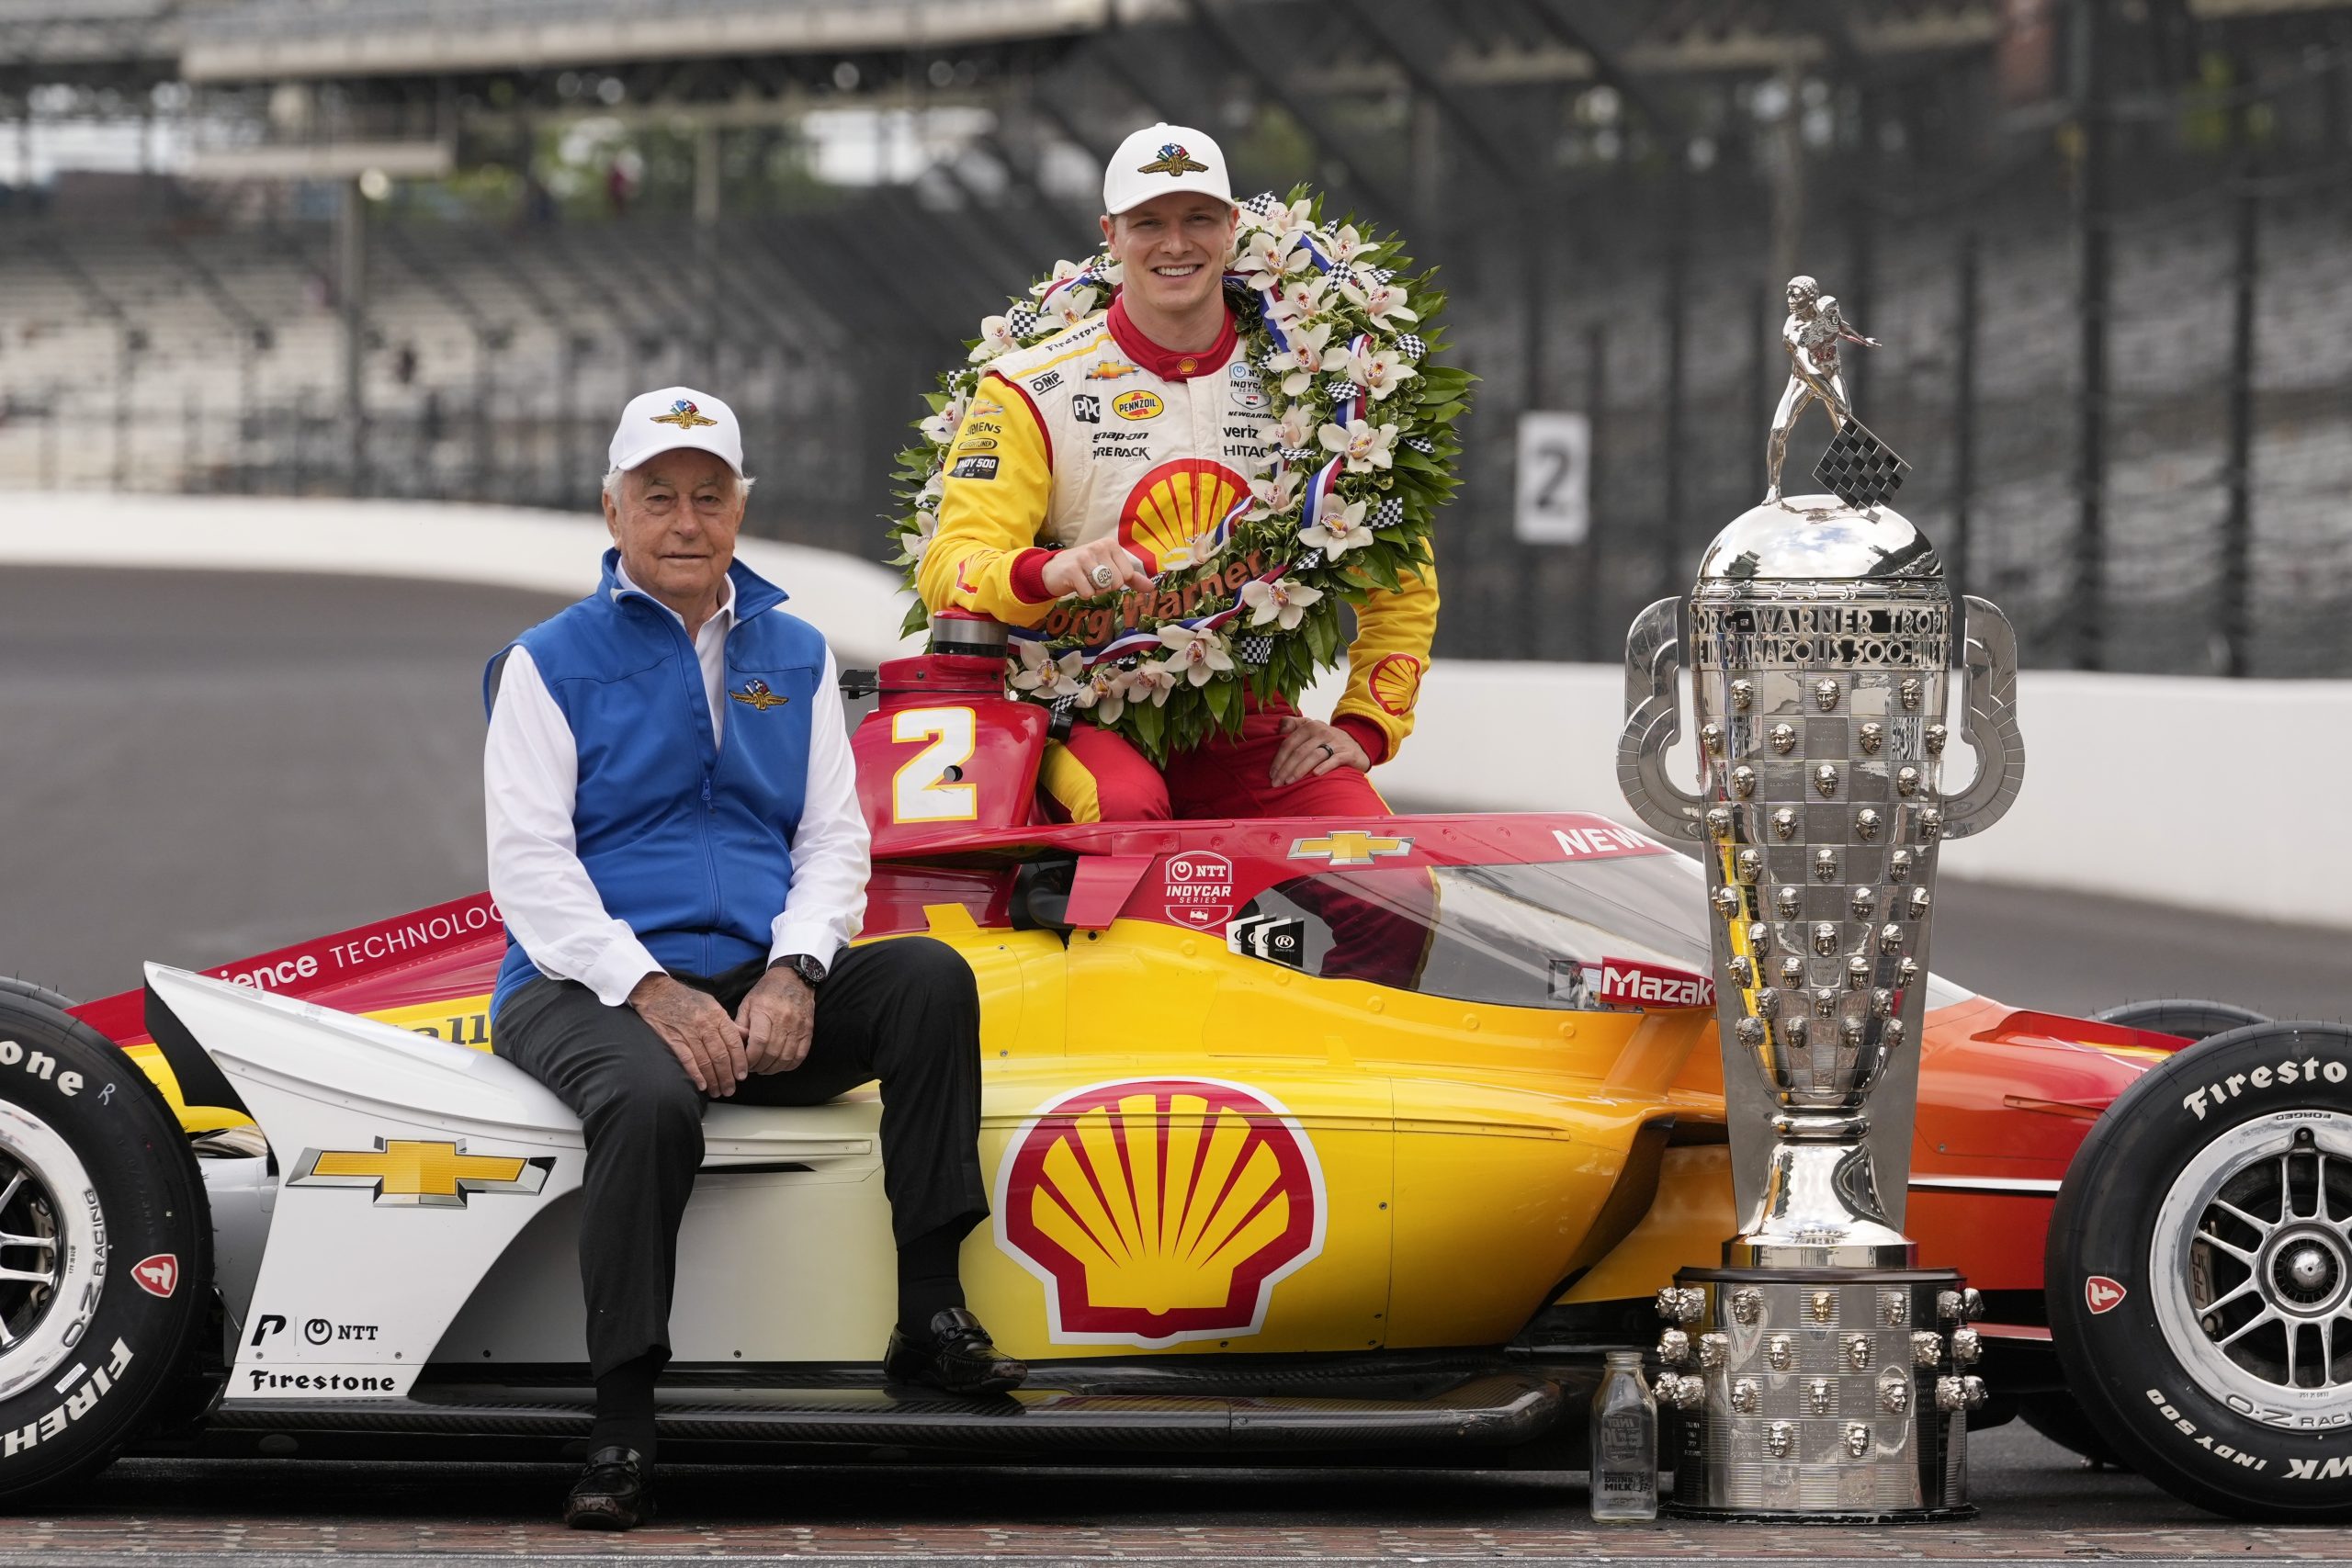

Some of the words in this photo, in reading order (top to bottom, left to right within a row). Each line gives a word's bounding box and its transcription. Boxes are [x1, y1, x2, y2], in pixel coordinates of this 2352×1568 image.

[1046, 321, 1105, 352] Firestone
[1033, 372, 1060, 392] OMP
[1119, 398, 1157, 412] PENNZOIL
[956, 457, 978, 469] INDY
[976, 457, 998, 469] 500
[1535, 437, 1572, 517] 2
[1098, 569, 1113, 582] 500
[1122, 548, 1265, 630] Warner
[892, 705, 978, 825] 2
[1195, 864, 1227, 877] NTT
[1166, 885, 1232, 897] INDYCAR
[1601, 966, 1713, 1006] Mazak
[82, 1188, 107, 1277] RACING
[338, 1325, 379, 1340] NTT
[249, 1370, 395, 1392] Firestone
[0, 1337, 135, 1458] FIREH
[2145, 1388, 2197, 1436] 500
[2193, 1436, 2268, 1471] INDY
[1604, 1483, 1632, 1492] MILK
